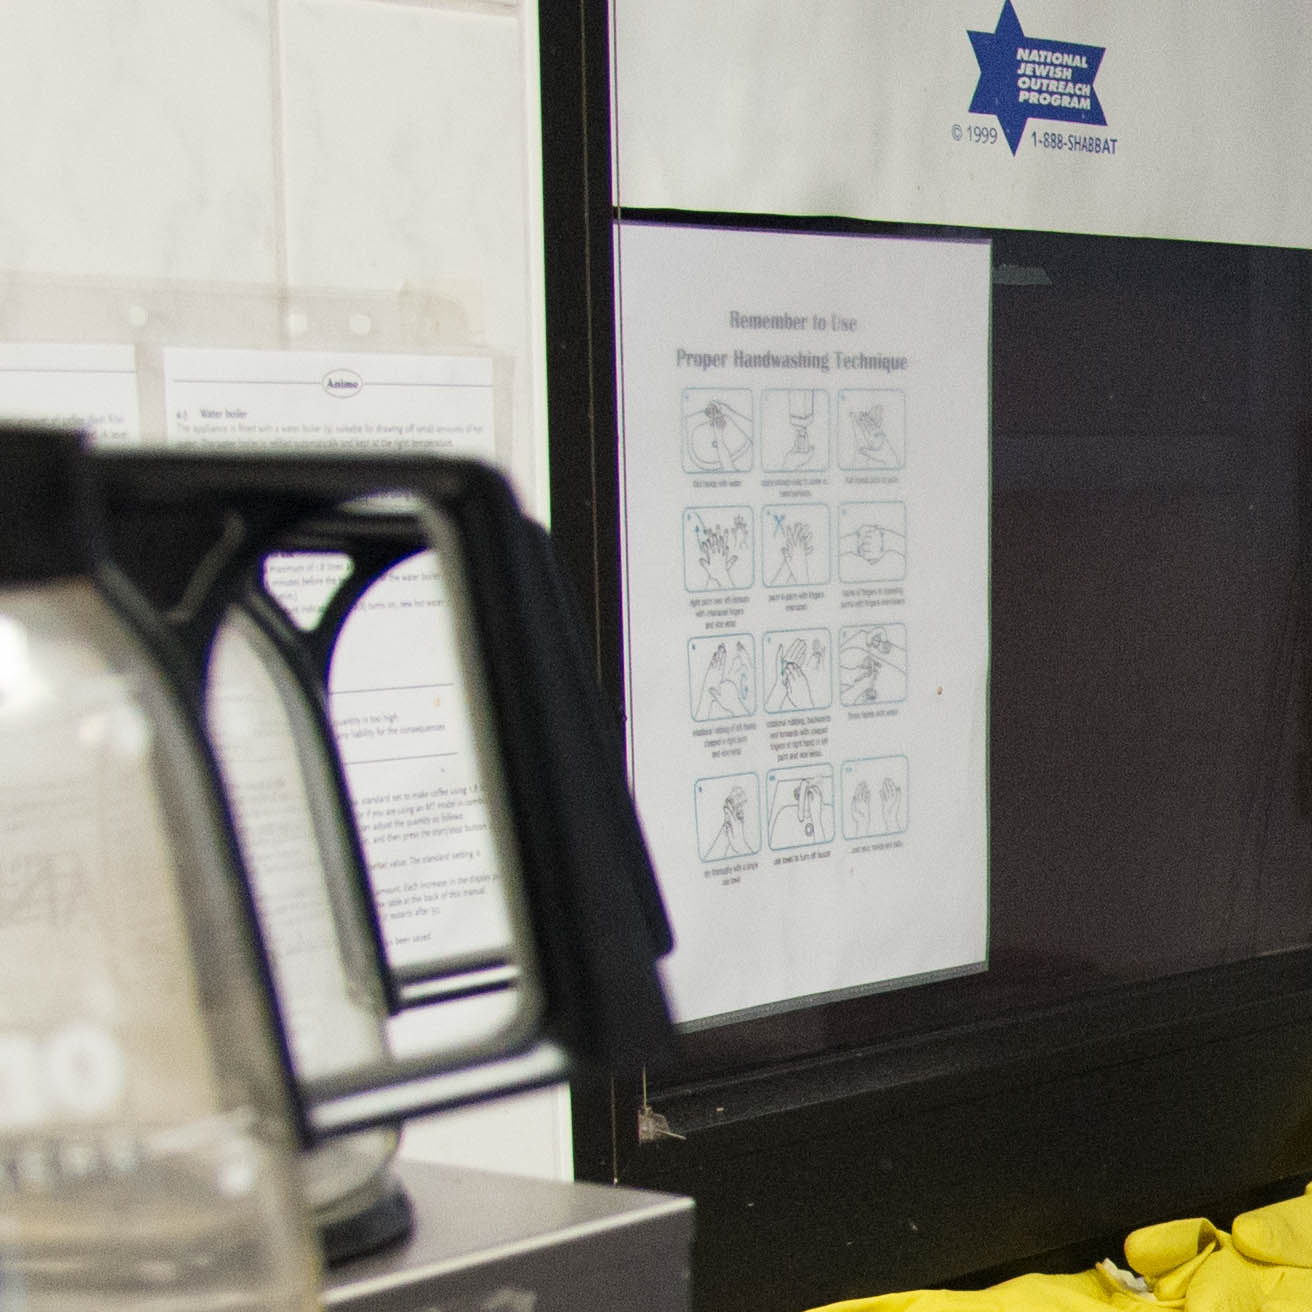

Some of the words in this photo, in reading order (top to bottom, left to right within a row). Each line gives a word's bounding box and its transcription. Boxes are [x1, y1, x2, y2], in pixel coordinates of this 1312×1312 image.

[1016, 47, 1088, 69] NATIONAL
[1017, 63, 1073, 80] JEWISH
[1017, 77, 1091, 97] OUTREACH
[1018, 90, 1091, 110] PROGRAM
[966, 125, 998, 145] 1999
[1031, 131, 1118, 155] 1-888-SHABBAT
[729, 310, 806, 331] Remember
[813, 314, 826, 331] to
[831, 314, 858, 332] Use
[676, 349, 727, 372] Proper
[733, 349, 831, 372] Handwashing
[834, 351, 909, 374] Technique
